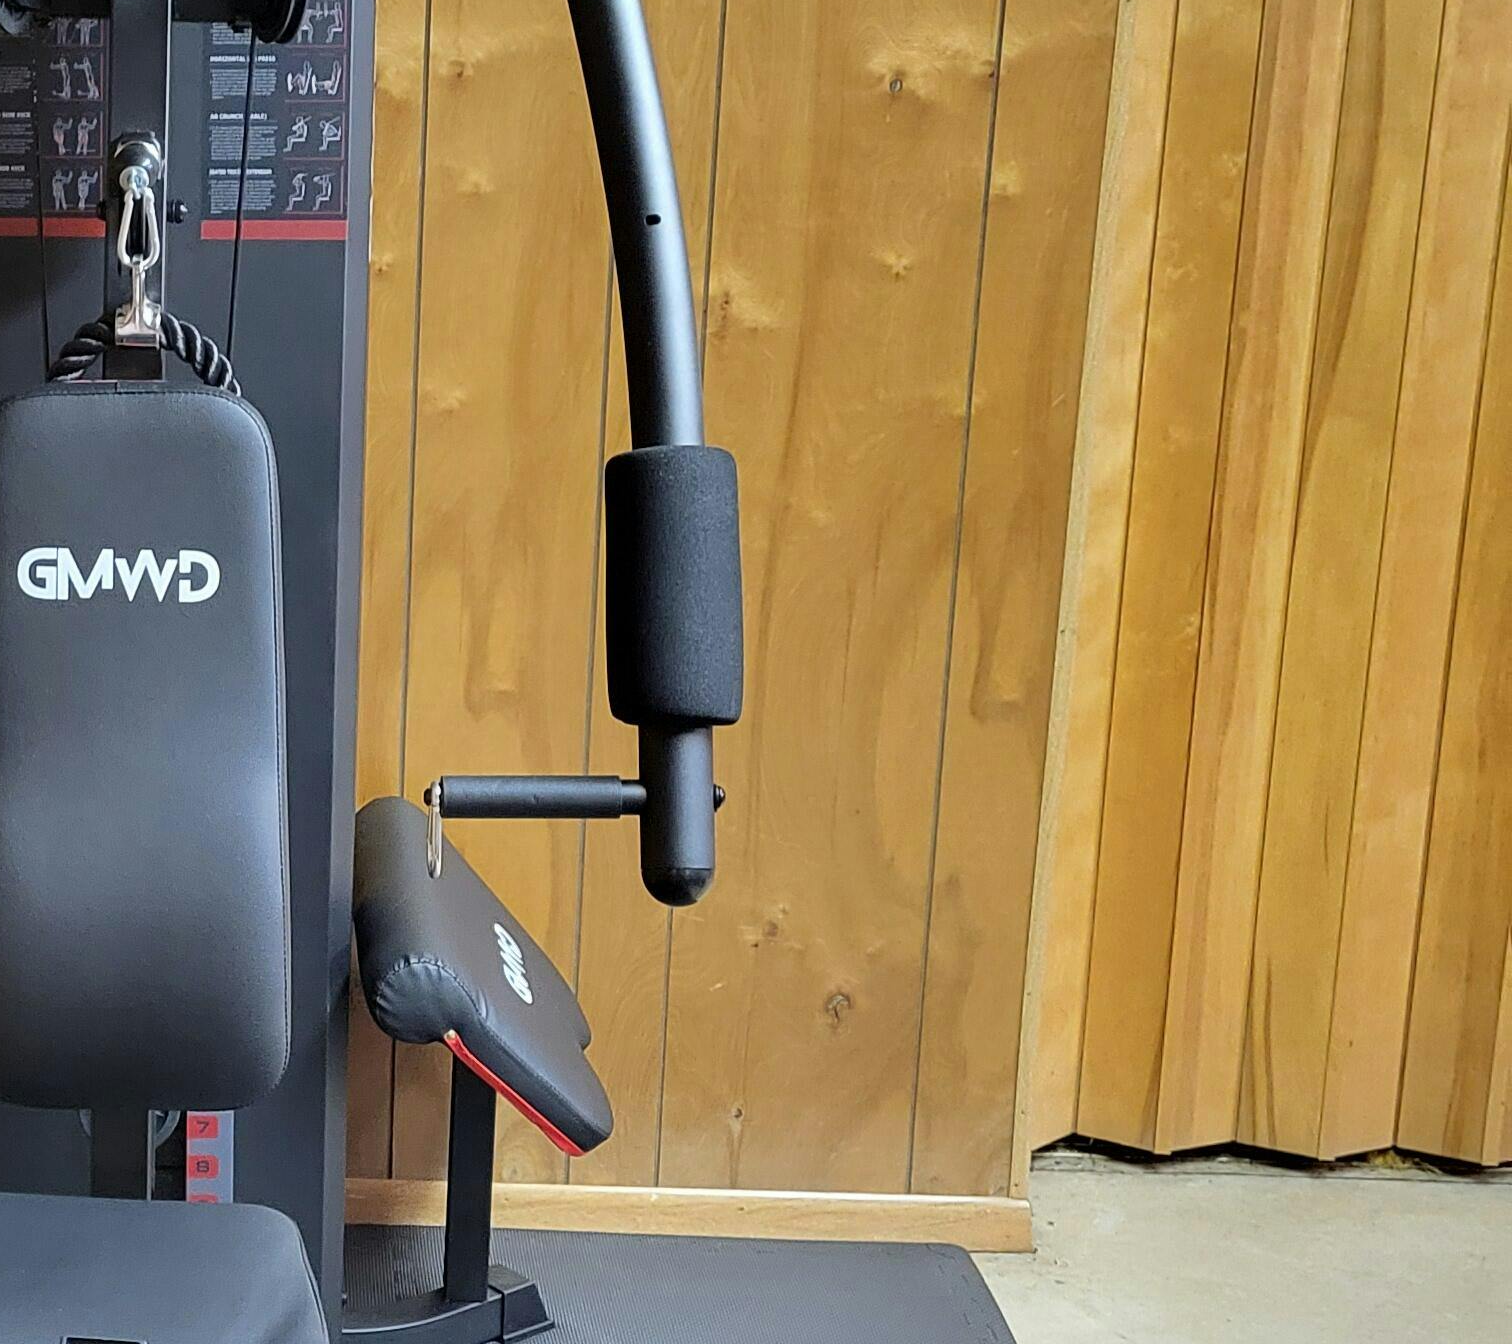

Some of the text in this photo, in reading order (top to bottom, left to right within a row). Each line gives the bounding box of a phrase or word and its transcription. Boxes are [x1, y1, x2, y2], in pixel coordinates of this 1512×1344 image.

[17, 546, 221, 604] GMWD
[196, 1121, 209, 1133] 7
[196, 1160, 210, 1173] 8
